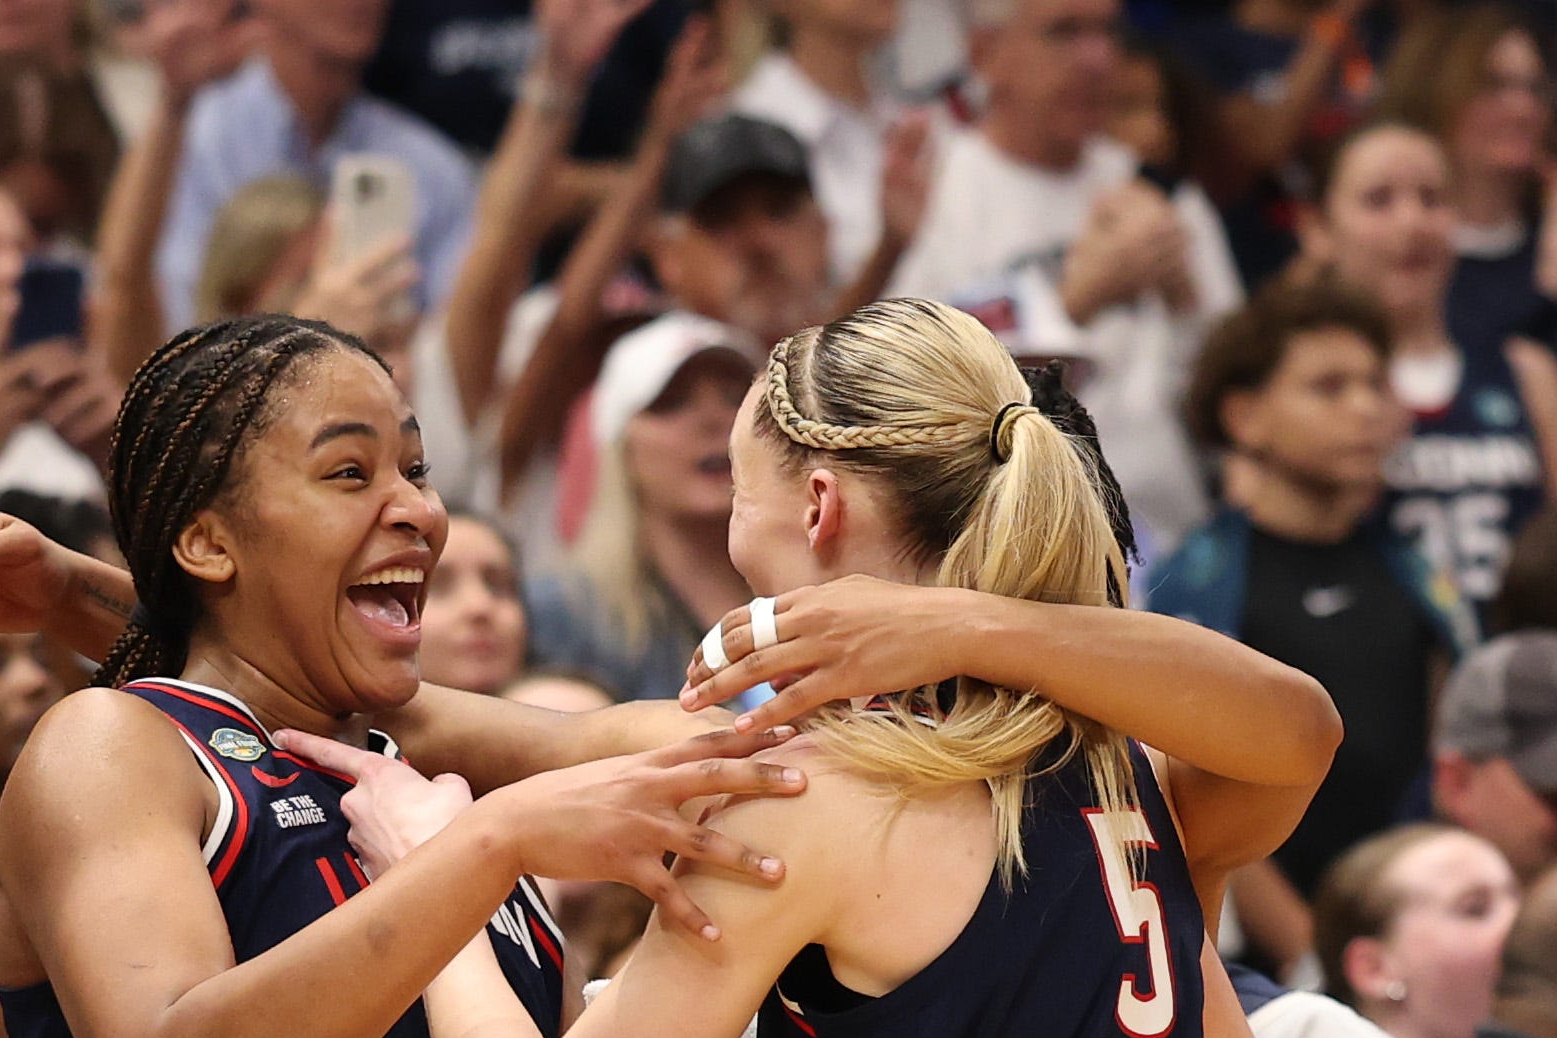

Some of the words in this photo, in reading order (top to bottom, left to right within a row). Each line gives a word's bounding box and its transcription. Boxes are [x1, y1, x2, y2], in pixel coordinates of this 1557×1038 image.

[270, 799, 293, 813] BE
[288, 794, 318, 809] THE
[276, 807, 327, 829] CHANGE
